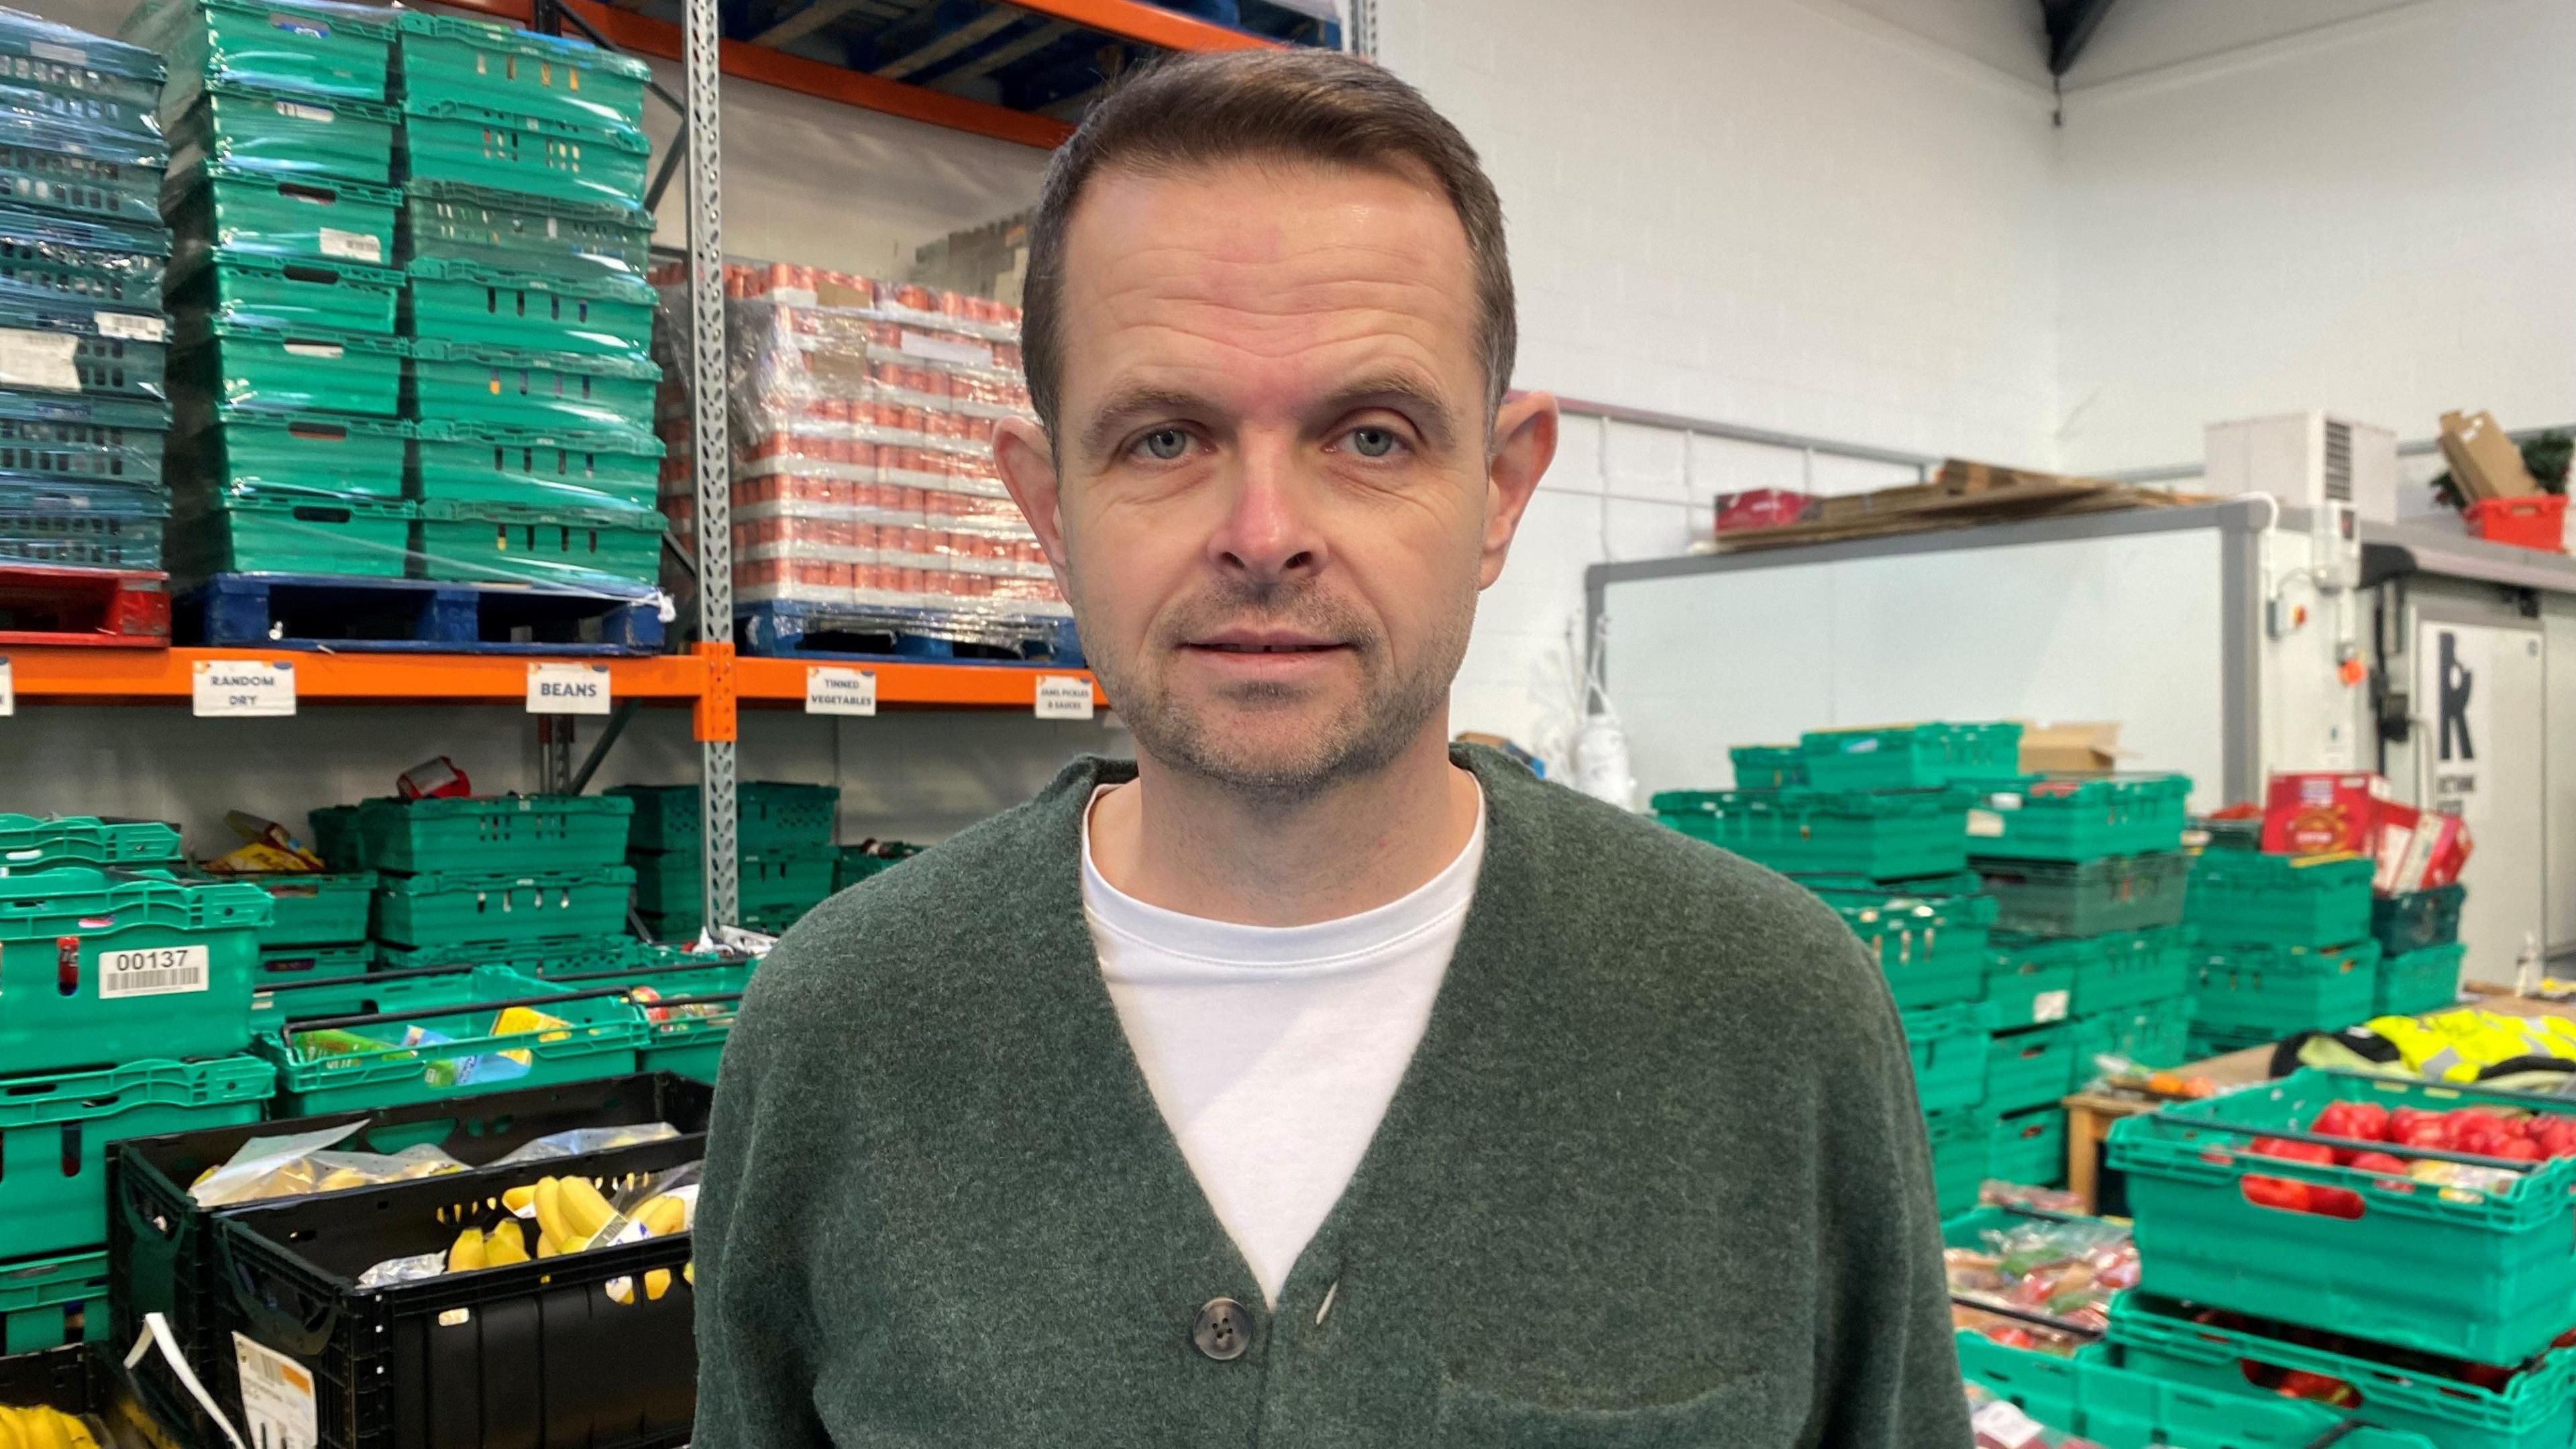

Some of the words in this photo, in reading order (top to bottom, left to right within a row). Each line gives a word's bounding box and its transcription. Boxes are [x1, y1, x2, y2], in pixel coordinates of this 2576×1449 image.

[211, 676, 275, 686] RANDOM
[825, 680, 859, 690] TINNED
[541, 683, 597, 698] BEANS
[229, 695, 257, 706] DRY
[811, 695, 871, 706] VEGETABLES
[117, 949, 188, 971] 00137
